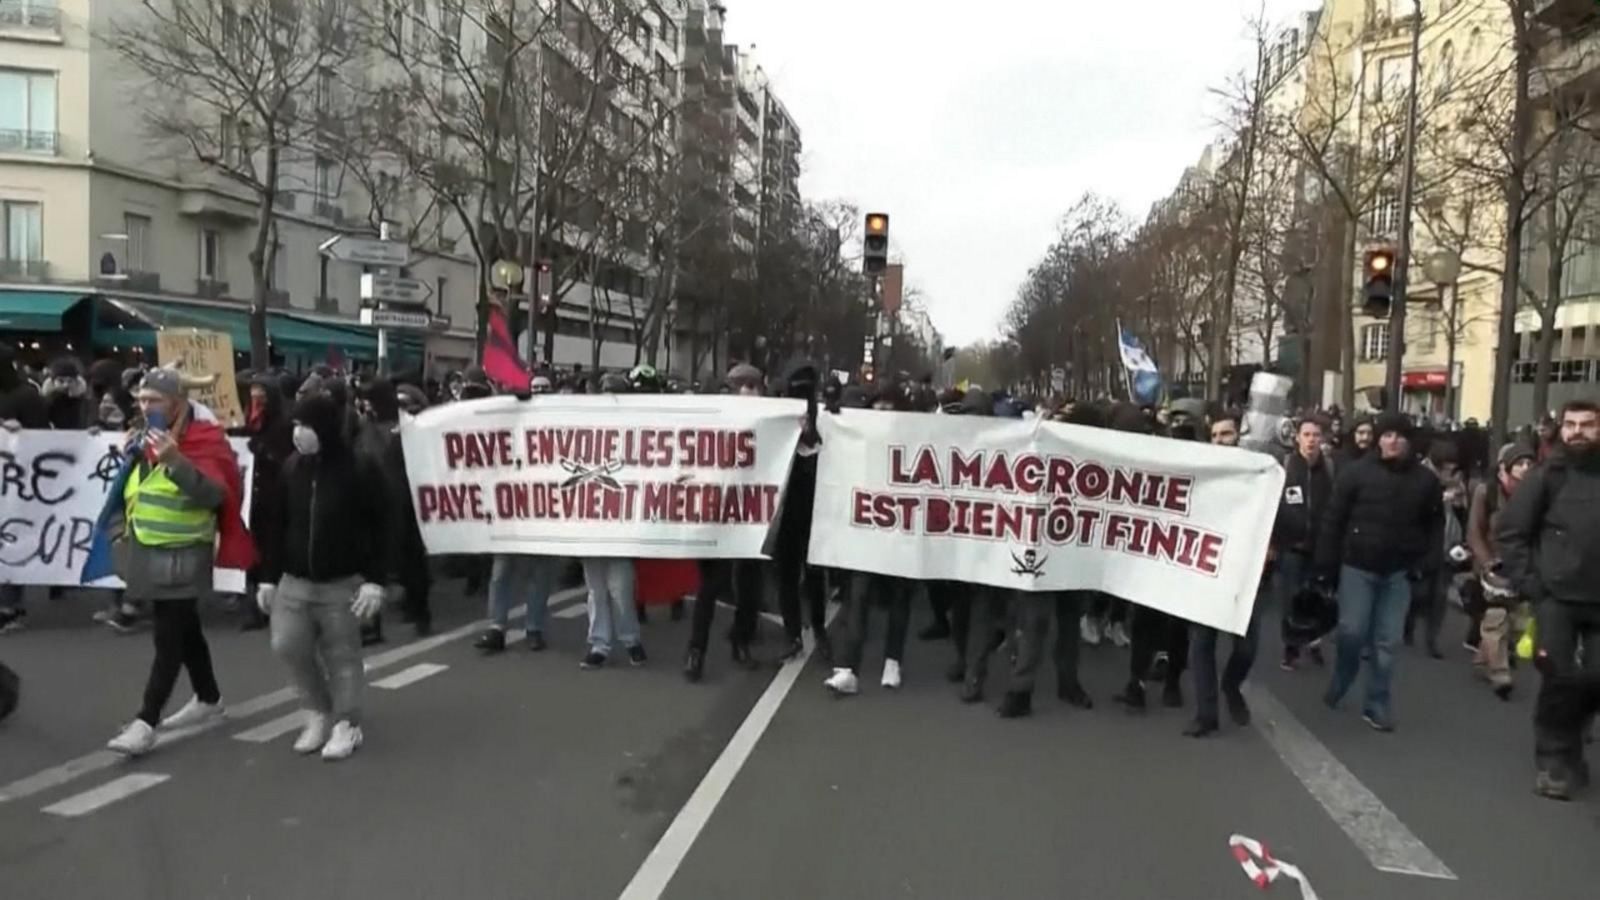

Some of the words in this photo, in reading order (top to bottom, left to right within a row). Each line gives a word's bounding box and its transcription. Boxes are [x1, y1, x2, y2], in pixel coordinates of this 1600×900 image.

[445, 430, 522, 470] PAYE,
[526, 429, 617, 466] ENVOIE
[623, 430, 674, 468] LES
[678, 429, 755, 468] SOUS
[417, 484, 493, 524] PAYE,
[495, 482, 529, 520] ON
[532, 482, 640, 521] DEVIENT
[642, 475, 780, 523] MÉCHANT
[889, 446, 941, 487] LA
[950, 449, 1193, 513] MACRONIE
[852, 489, 918, 532] EST
[924, 498, 1101, 545] BIENTÔT
[1106, 514, 1225, 575] FINIE
